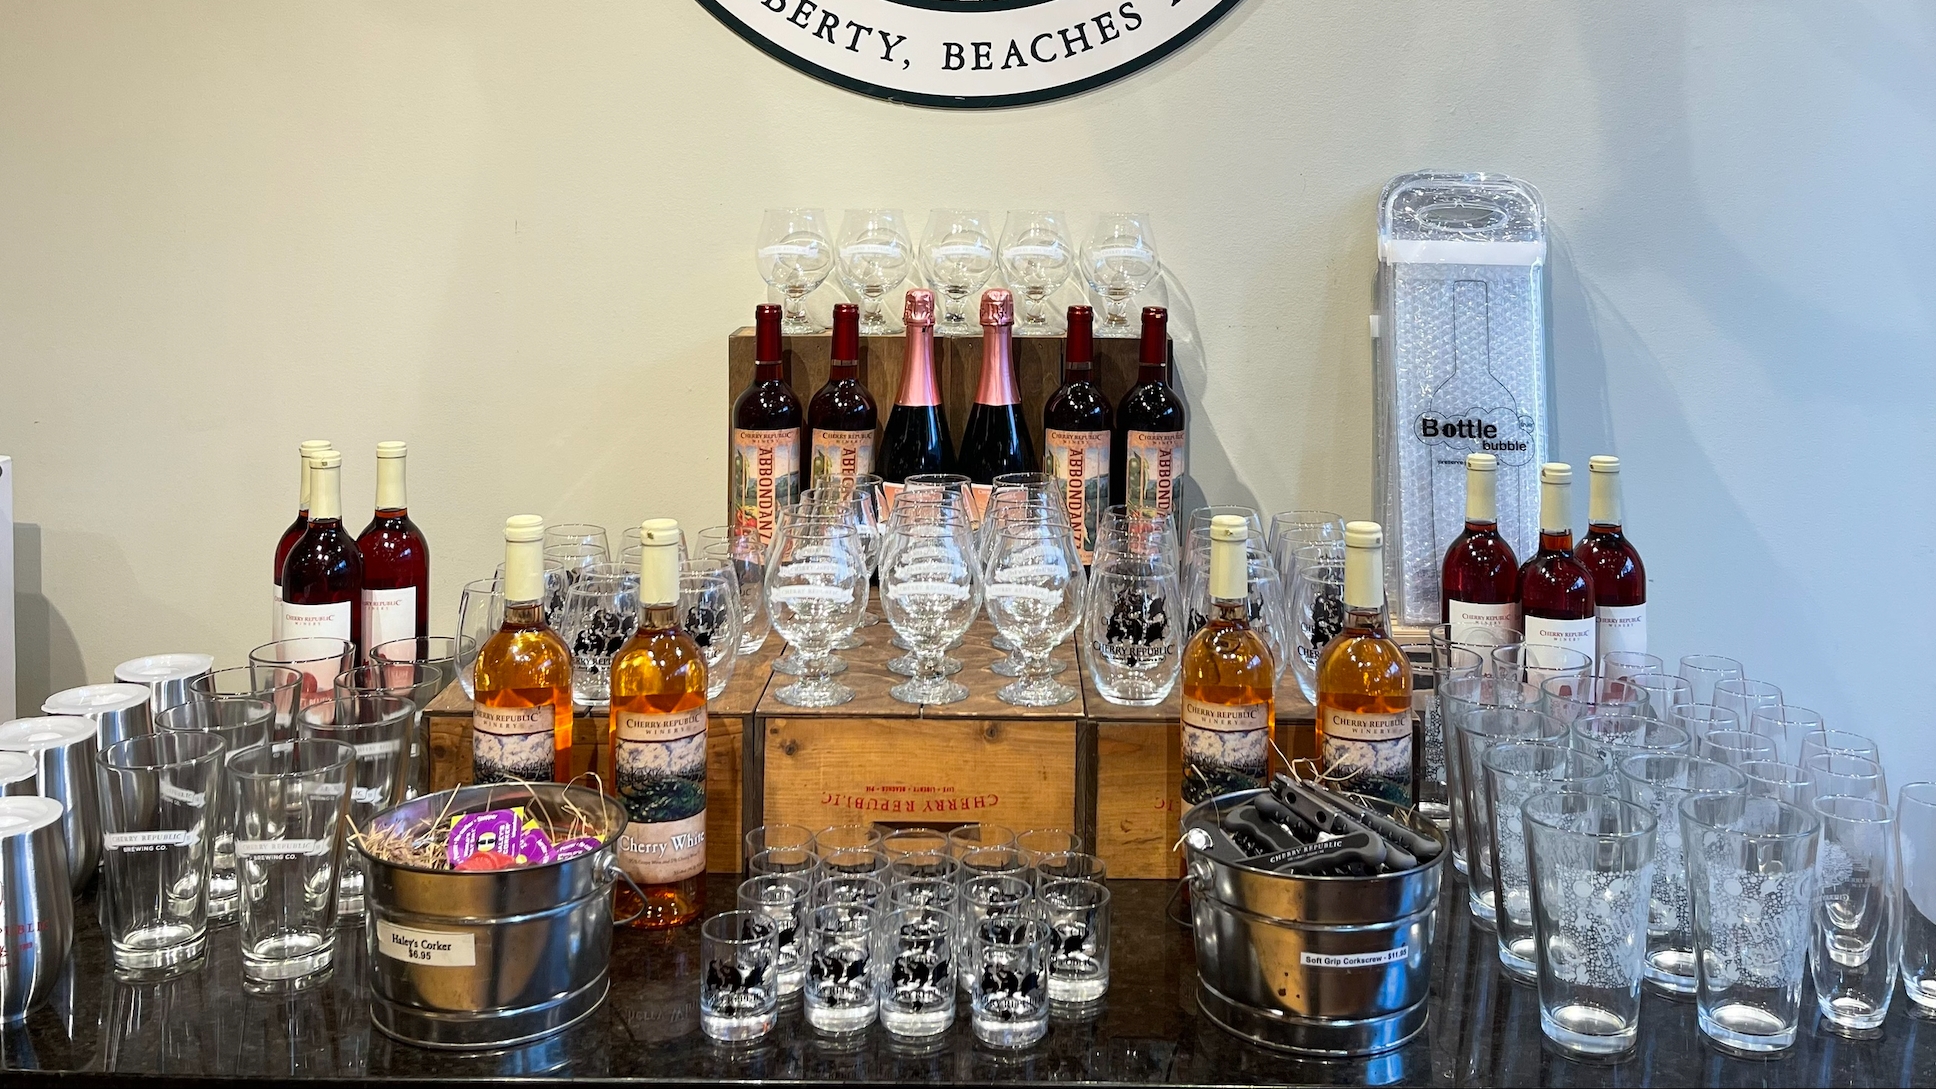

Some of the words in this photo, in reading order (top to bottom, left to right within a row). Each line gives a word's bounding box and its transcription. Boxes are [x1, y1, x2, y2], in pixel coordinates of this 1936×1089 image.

[941, 2, 1142, 70] BEACHES
[1422, 418, 1497, 439] Bottle
[740, 432, 763, 440] CHERRY
[1051, 432, 1074, 440] CHERRY
[1482, 441, 1527, 451] bubble
[1093, 640, 1127, 656] CHERRY
[1129, 644, 1175, 657] REPUBLIC
[1297, 645, 1320, 658] CHER
[496, 712, 538, 722] REPUBLIC
[1186, 703, 1215, 717] CHERRY
[1216, 709, 1257, 719] REPUBLIC
[483, 721, 517, 729] WINERY
[626, 718, 662, 728] CHERRY
[663, 714, 700, 728] REPUBLIC
[1201, 717, 1239, 725] WINERY
[1333, 715, 1367, 728] CHERRY
[1369, 716, 1406, 728] REPUBLIC
[645, 727, 684, 735] WINERY
[821, 791, 915, 812] REPUBLIC
[922, 793, 999, 812] CHERRY
[141, 833, 182, 841] REPUBLIC
[123, 845, 154, 853] BREWING
[271, 842, 311, 850] REPUBLIC
[620, 835, 667, 859] Cherry
[671, 831, 705, 851] White
[1269, 848, 1302, 864] CHERRY
[1303, 840, 1343, 854] REPUBLIC
[392, 933, 418, 949] Haley's
[421, 940, 452, 951] Corker
[409, 949, 431, 960] $6.95
[1305, 956, 1322, 964] Soft
[1324, 957, 1341, 966] Grip
[1343, 957, 1383, 965] Corkscrew
